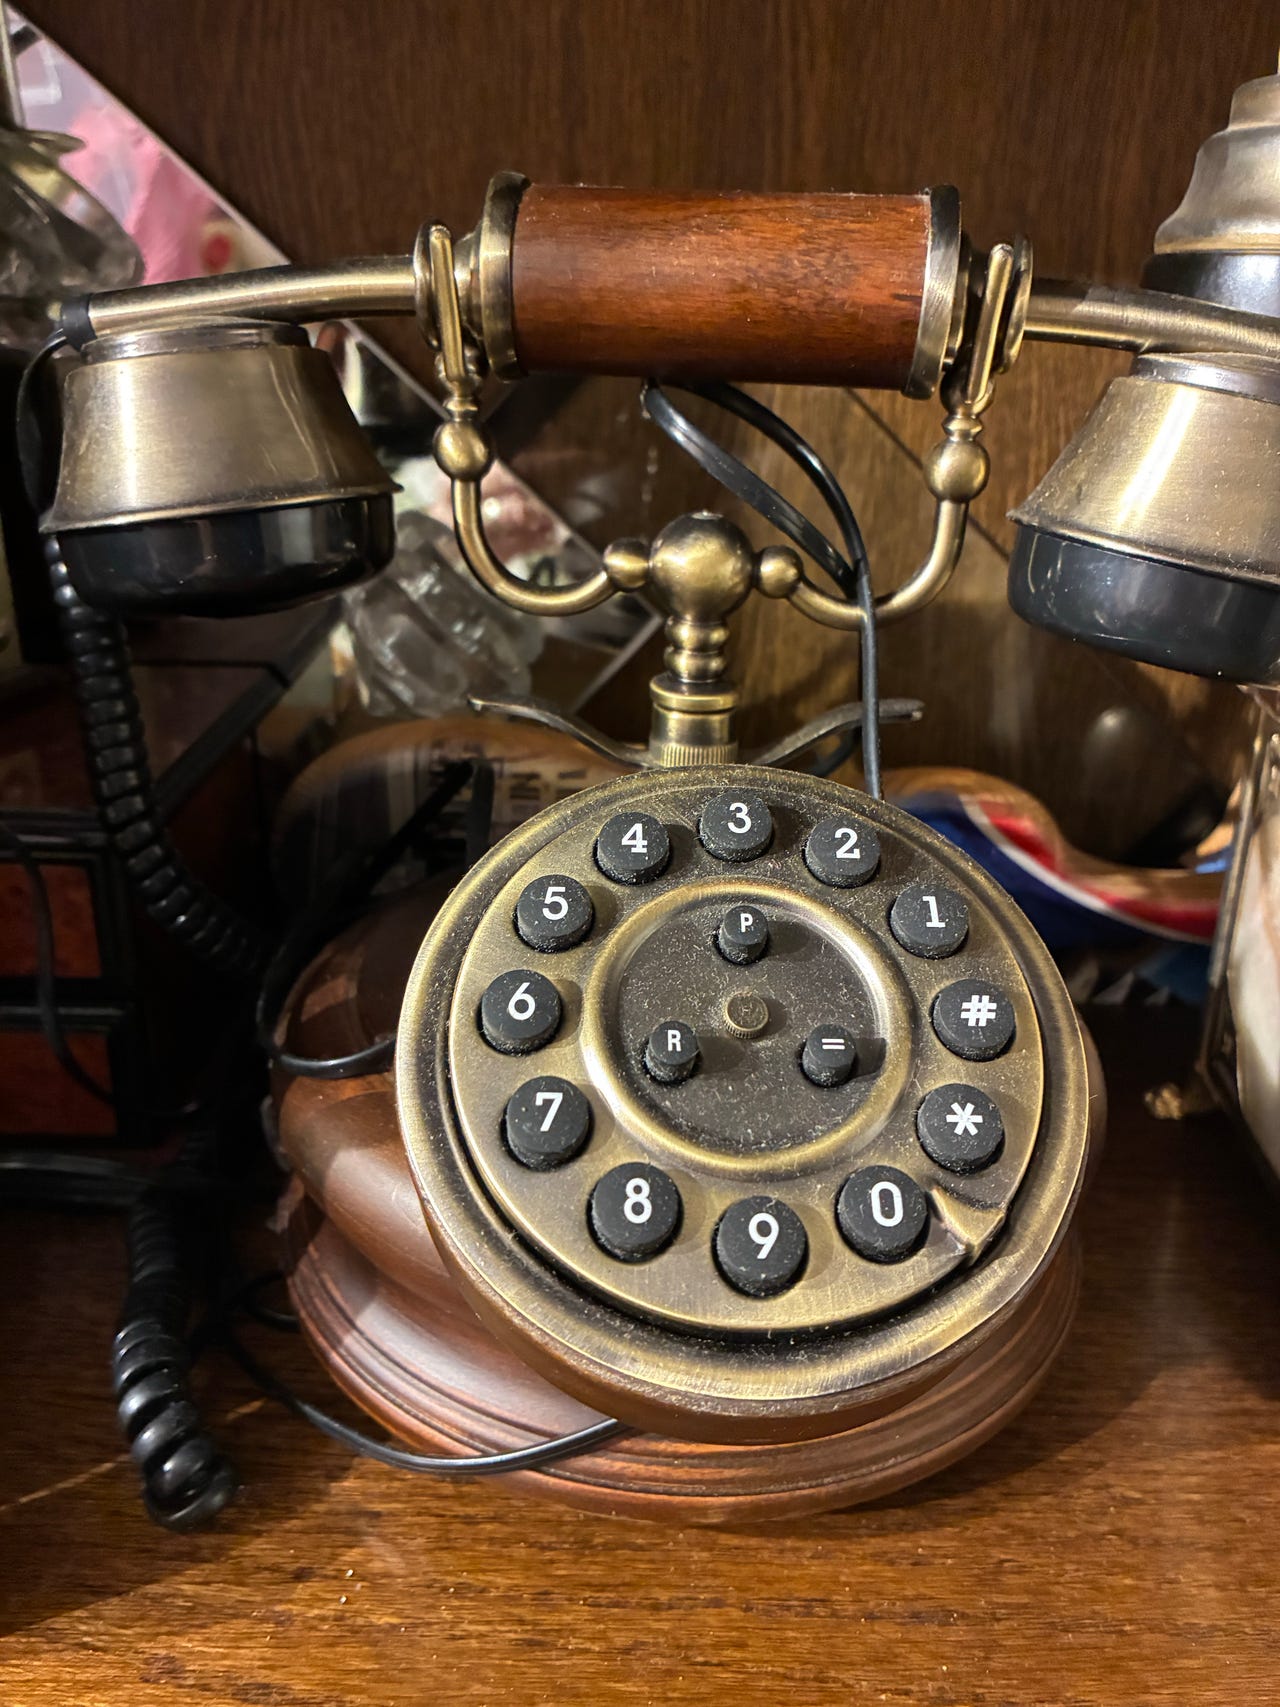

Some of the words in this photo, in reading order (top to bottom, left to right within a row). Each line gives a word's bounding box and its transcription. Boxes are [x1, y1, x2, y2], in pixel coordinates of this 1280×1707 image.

[727, 802, 752, 834] 3
[621, 822, 648, 854] 4
[834, 827, 861, 860] 2
[542, 886, 569, 921] 5
[921, 895, 946, 929] 1
[740, 912, 754, 933] P
[506, 982, 536, 1021] 6
[960, 994, 998, 1027] #
[667, 1029, 682, 1052] R
[534, 1091, 564, 1132] 7
[623, 1177, 653, 1224] 8
[868, 1181, 904, 1228] 0
[748, 1212, 780, 1260] 9
